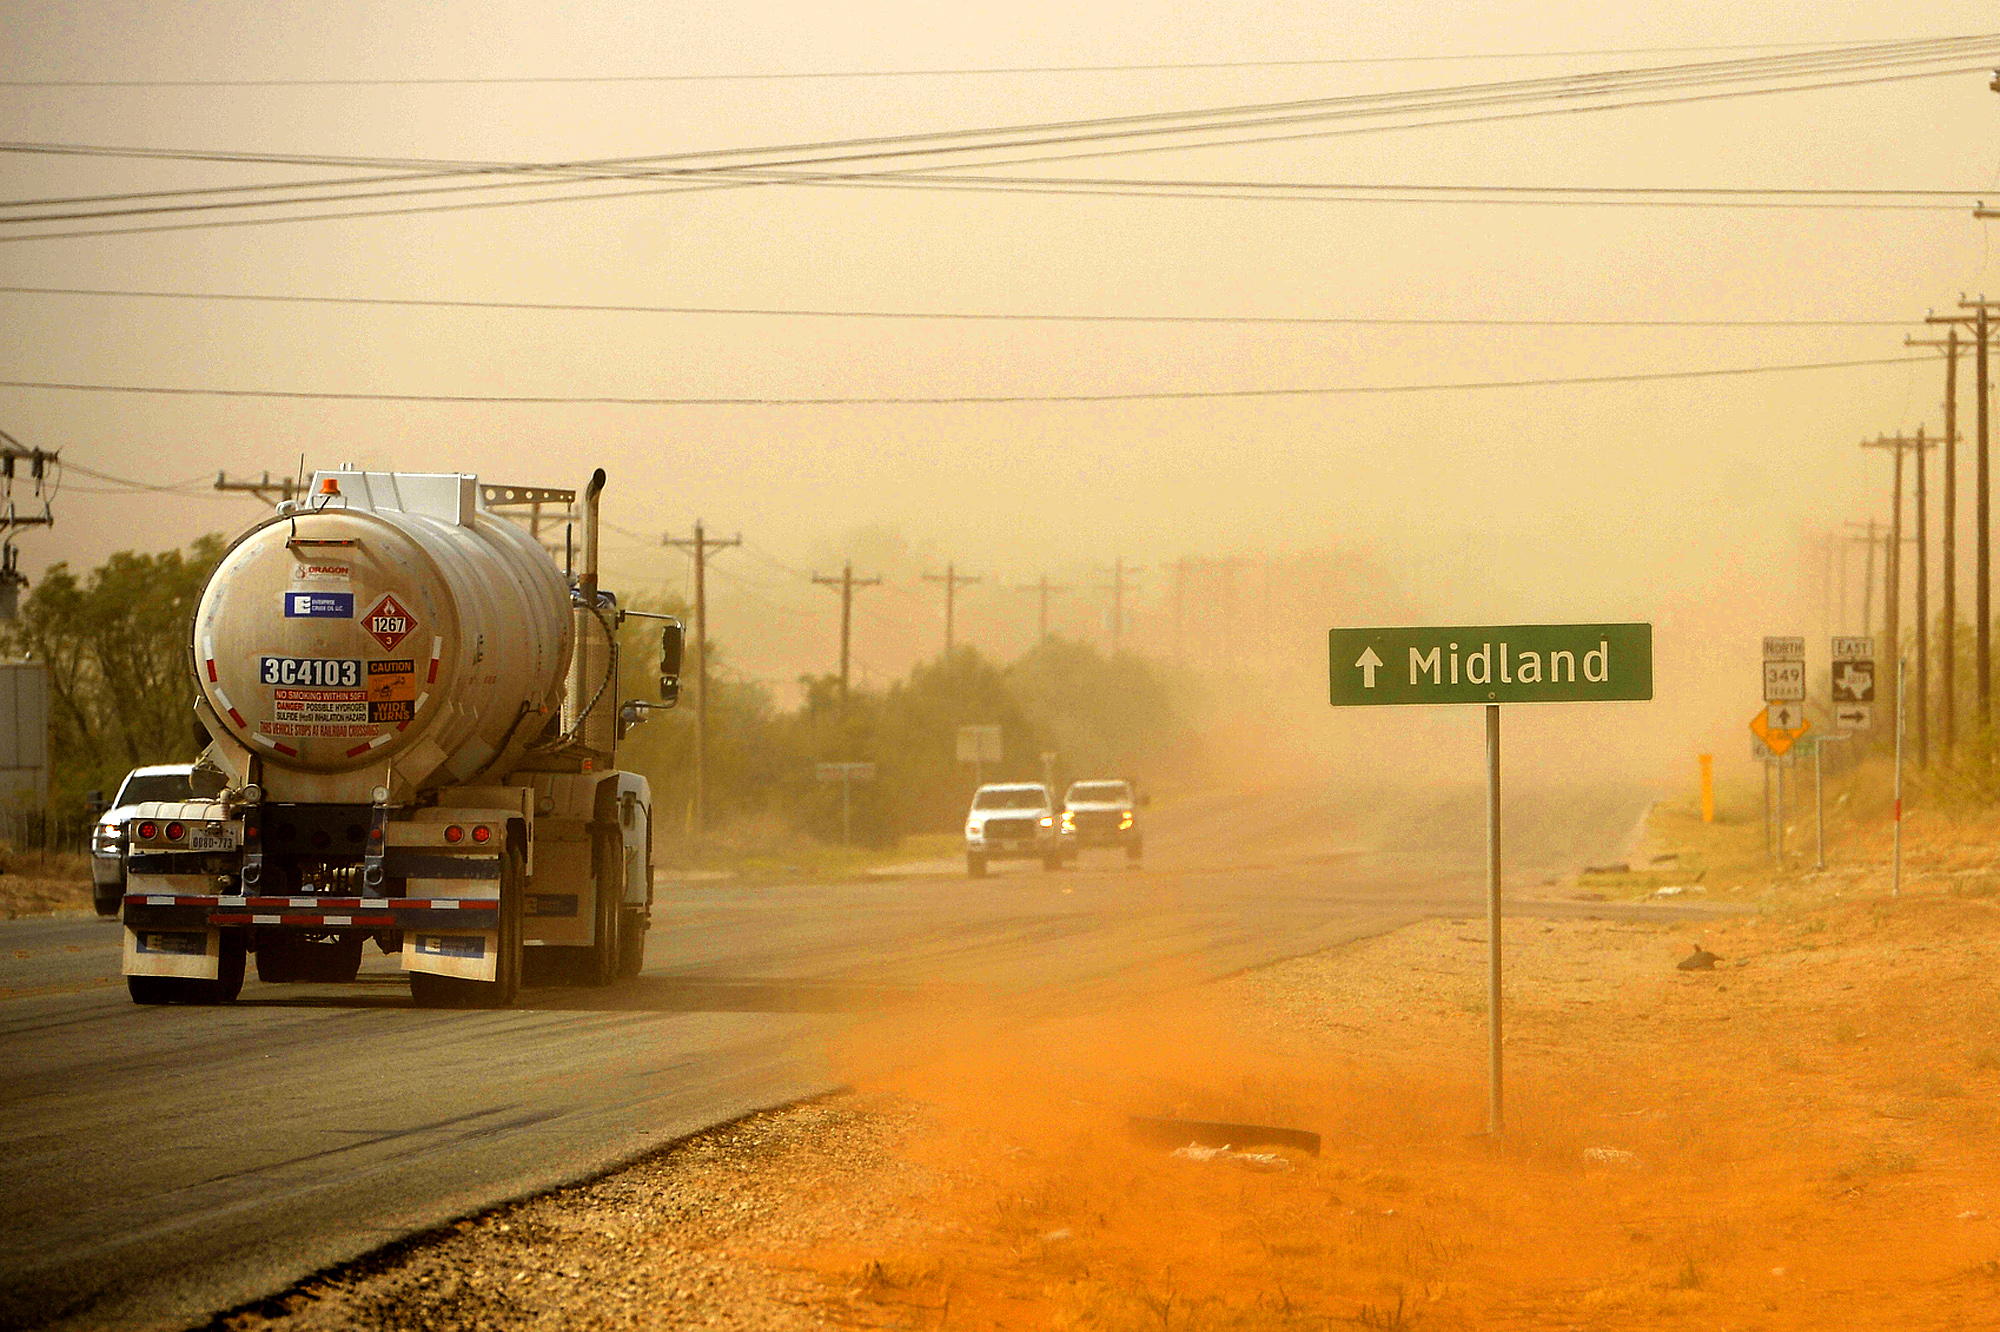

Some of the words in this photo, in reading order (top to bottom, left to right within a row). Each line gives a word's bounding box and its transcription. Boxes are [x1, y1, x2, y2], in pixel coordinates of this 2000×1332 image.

[308, 566, 349, 574] DRAGON
[374, 618, 404, 633] 1267
[386, 636, 392, 645] 3
[1766, 641, 1803, 654] NORTH
[1837, 642, 1868, 655] EAST
[371, 661, 412, 673] CAUTION
[1408, 641, 1609, 685] Midland
[265, 658, 357, 687] 3C4103
[1768, 668, 1799, 683] 349
[276, 690, 287, 699] NO
[288, 691, 321, 700] SMOKING
[323, 692, 348, 700] WITHIN
[350, 692, 366, 700] 50FT
[306, 702, 334, 712] POSSIBLE
[336, 703, 367, 712] HYDROGEN
[377, 702, 406, 712] WIDE
[276, 712, 298, 721] SULFIDE
[315, 713, 344, 721] INHALATION
[345, 713, 367, 722] HAZARD
[374, 711, 411, 721] TURNS
